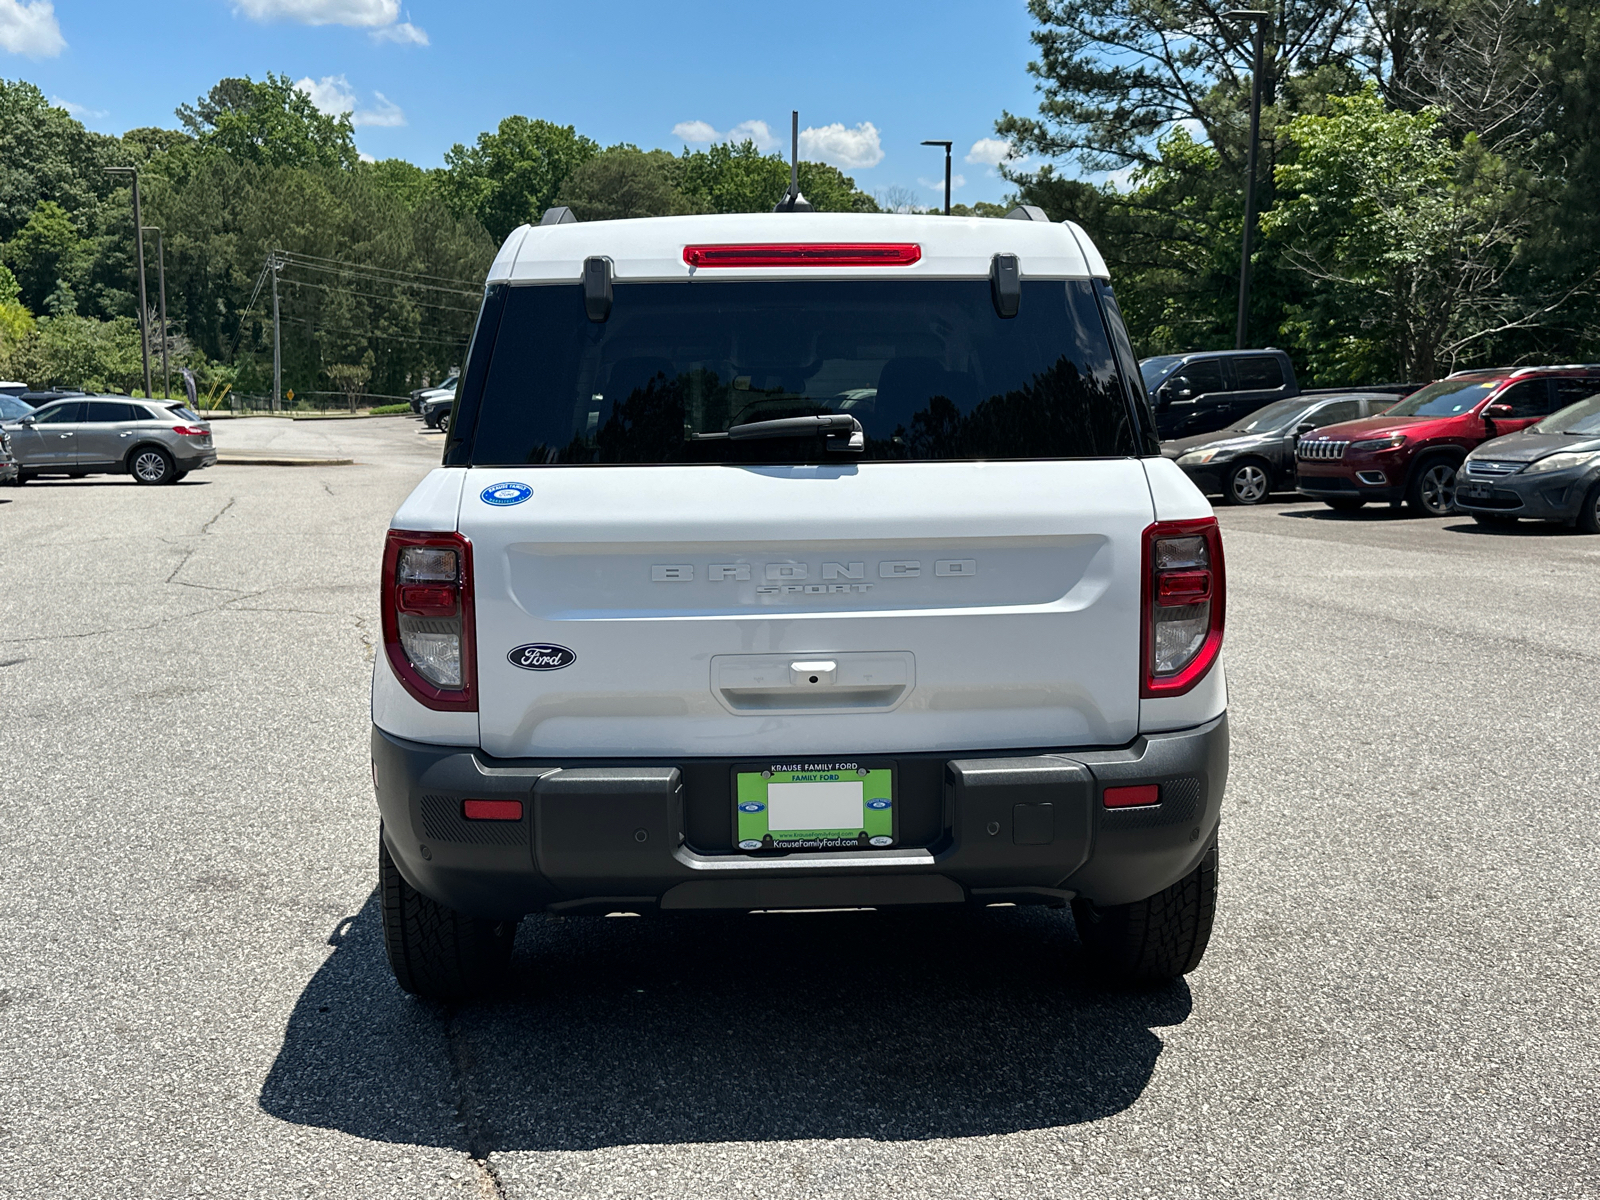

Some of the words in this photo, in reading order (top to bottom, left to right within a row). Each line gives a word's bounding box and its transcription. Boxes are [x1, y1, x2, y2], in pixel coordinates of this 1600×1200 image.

[651, 558, 977, 582] BRONCO
[756, 582, 874, 595] SPORT
[521, 648, 563, 666] Ford
[771, 763, 802, 772] KRAUSE
[804, 763, 833, 771] FAMILY
[835, 762, 858, 770] FORD
[791, 774, 818, 782] FAMILY
[773, 838, 858, 849] KrauseFamilyFord.com
